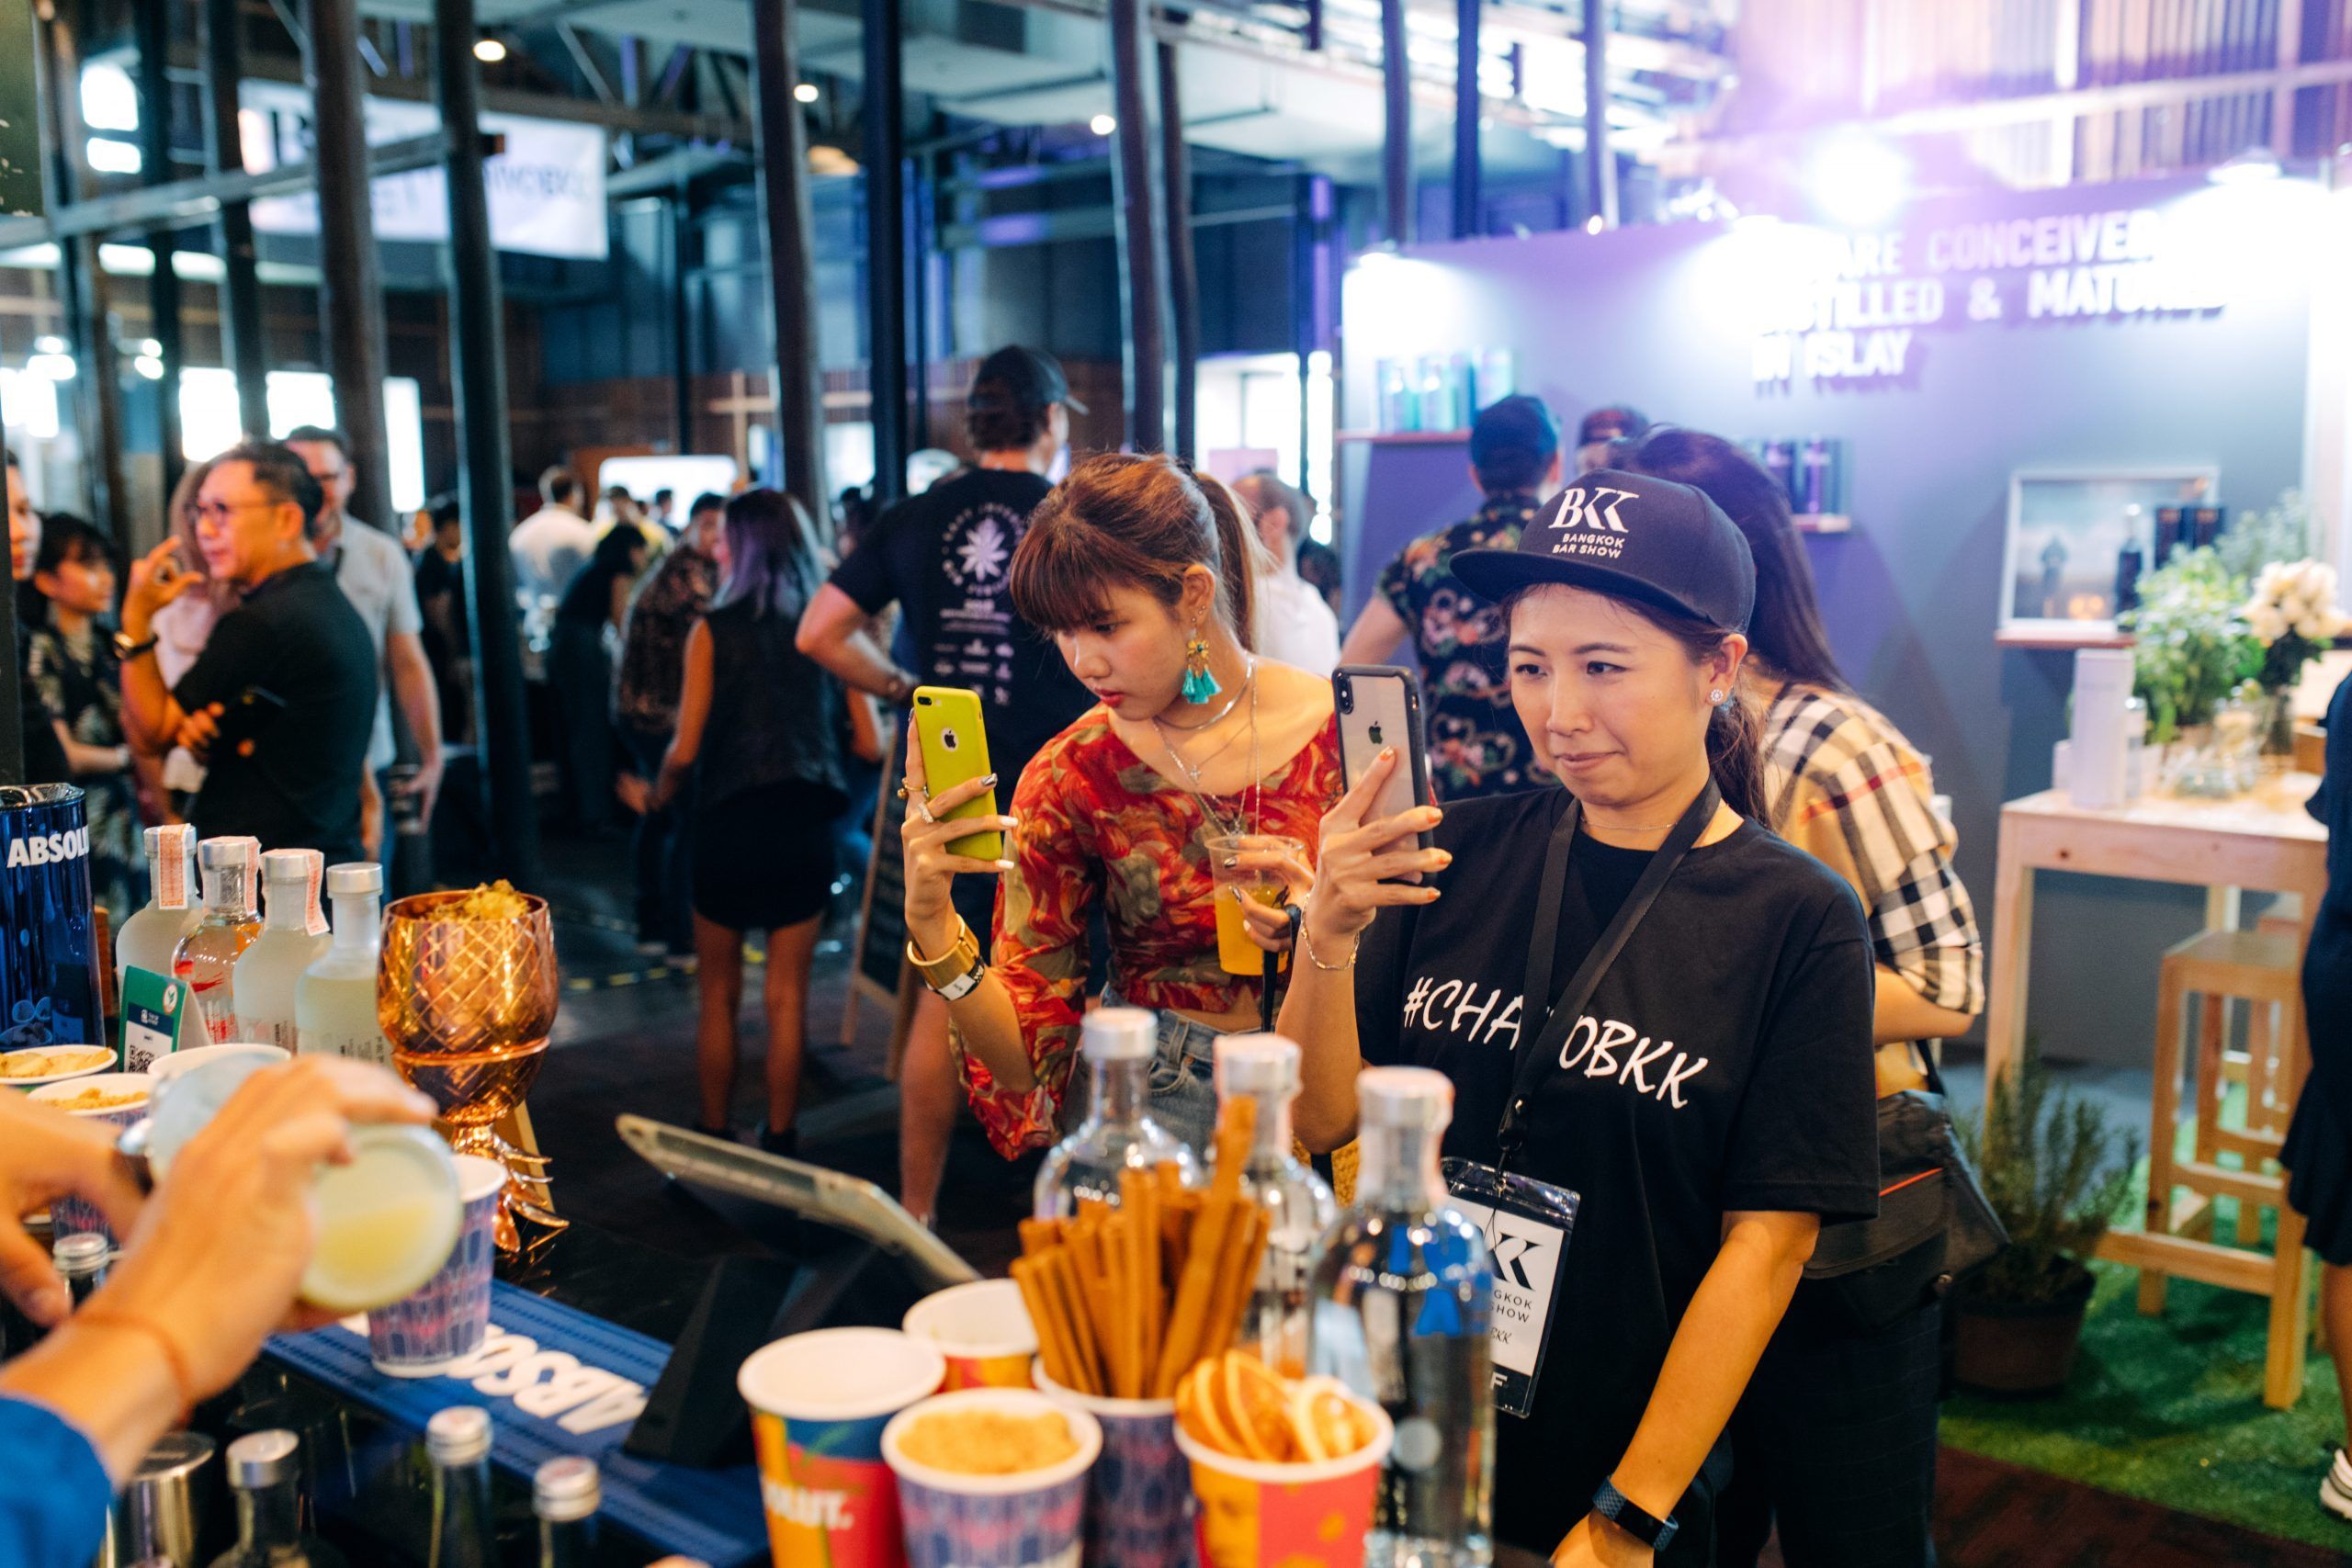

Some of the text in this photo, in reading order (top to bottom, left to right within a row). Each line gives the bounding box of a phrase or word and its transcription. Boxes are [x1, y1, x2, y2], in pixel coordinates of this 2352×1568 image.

[1928, 209, 2159, 273] CONCEIVED
[1968, 277, 2002, 321] &
[1804, 329, 1913, 378] ISLAY
[1548, 487, 1640, 533] BKK
[1552, 544, 1622, 558] BAR SHOW
[1563, 533, 1625, 549] BANGKOK
[1404, 976, 1709, 1109] #CHAOBKK
[1494, 1289, 1532, 1310] GKOK
